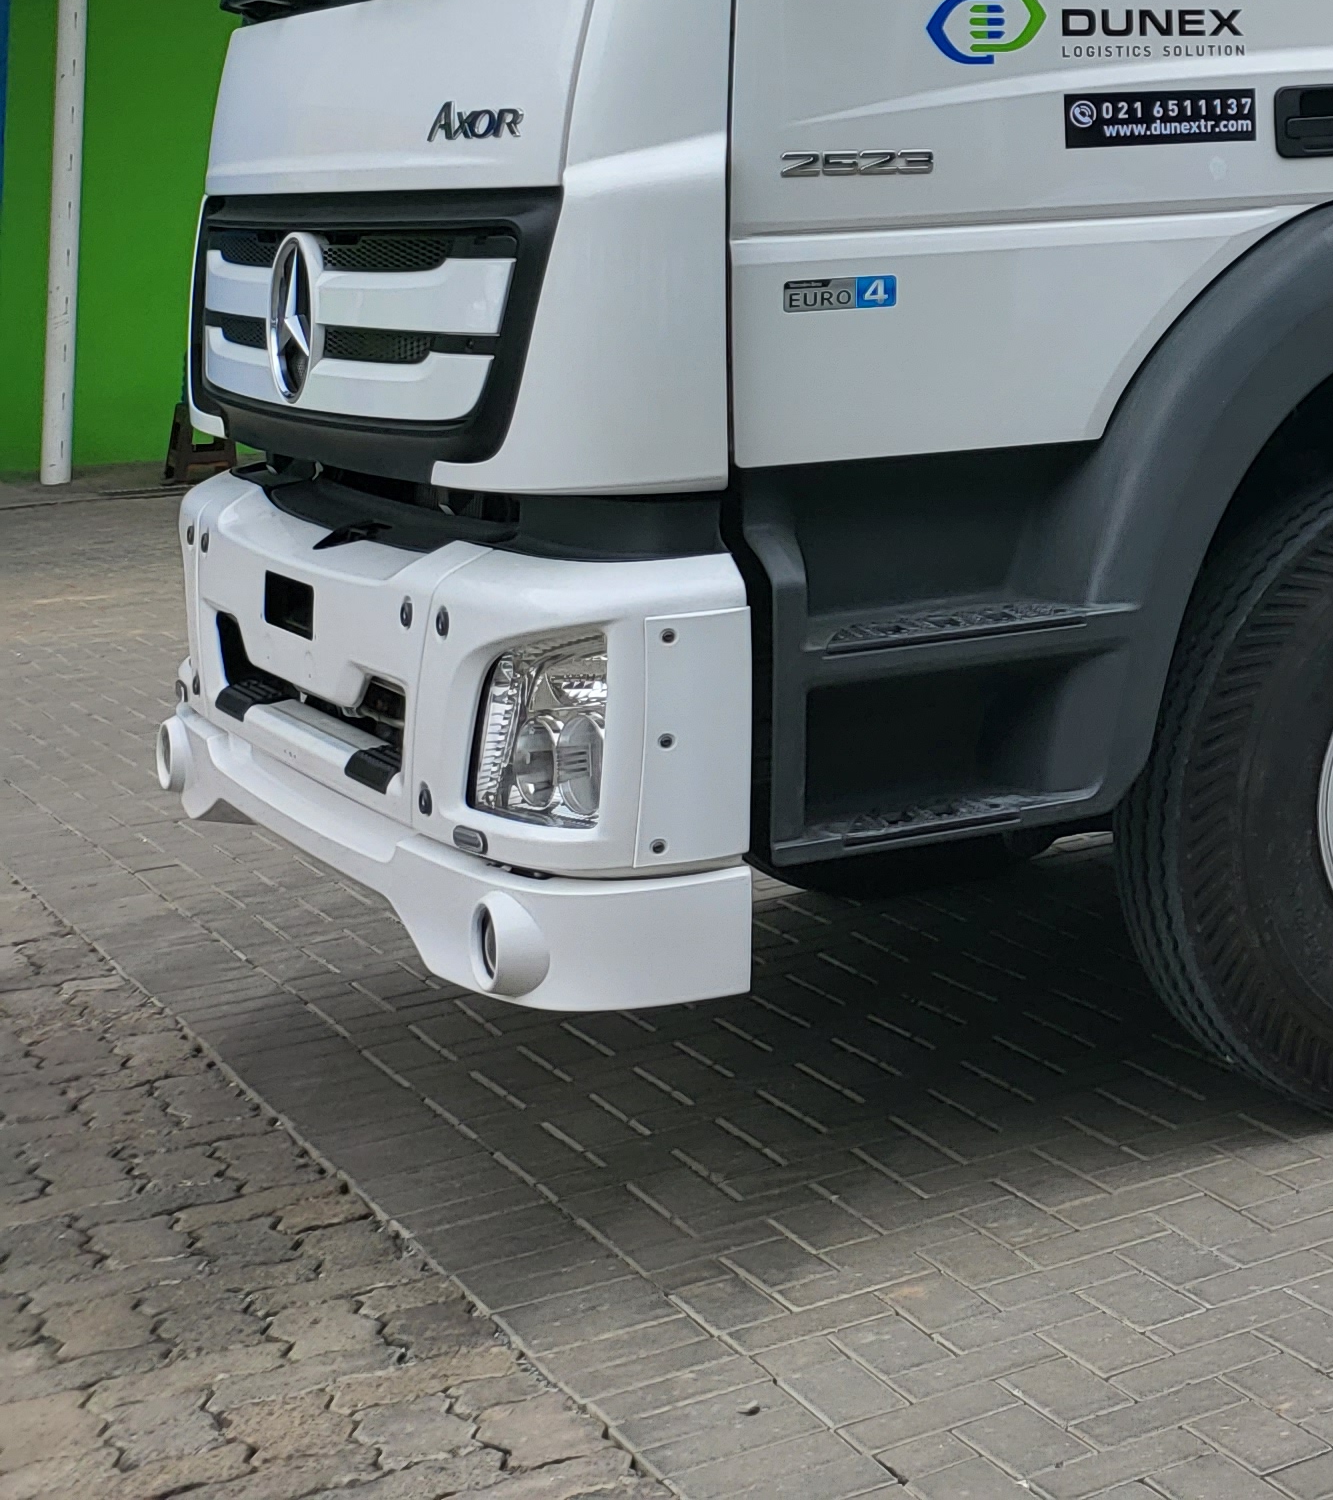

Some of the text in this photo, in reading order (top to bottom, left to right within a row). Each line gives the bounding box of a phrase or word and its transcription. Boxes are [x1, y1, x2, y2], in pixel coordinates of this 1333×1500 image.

[1061, 8, 1244, 37] DUNEX
[1062, 44, 1246, 58] LOGISTICS SOLUTION
[1102, 98, 1252, 119] 021 6511137
[1103, 119, 1252, 137] www.dunextr.com
[780, 149, 934, 178] 2523
[789, 279, 889, 308] EURO 4
